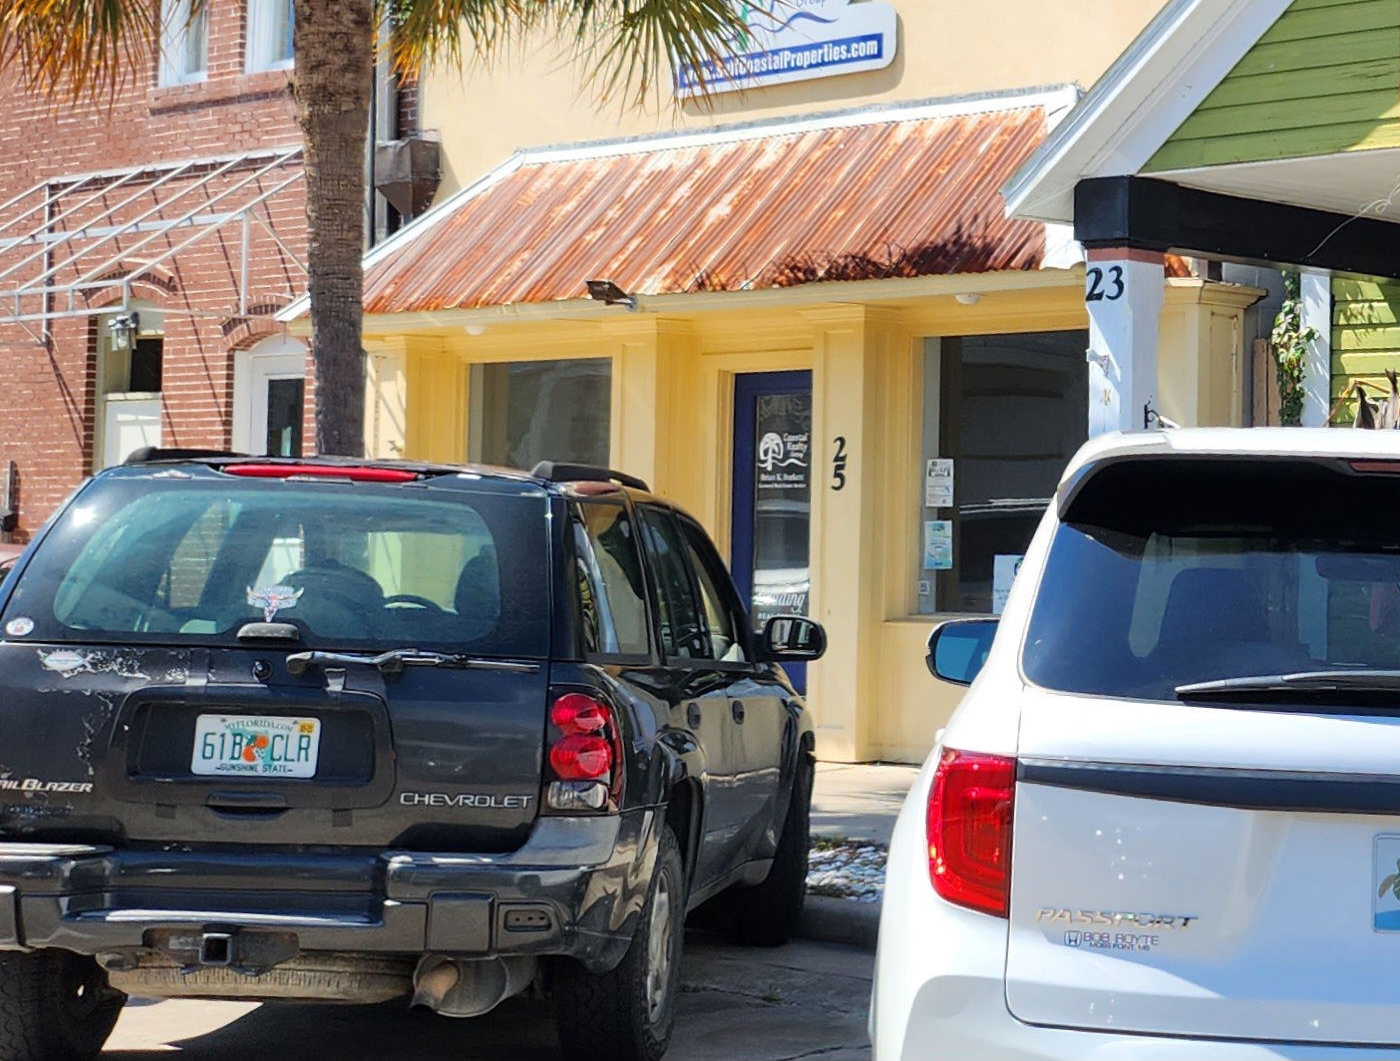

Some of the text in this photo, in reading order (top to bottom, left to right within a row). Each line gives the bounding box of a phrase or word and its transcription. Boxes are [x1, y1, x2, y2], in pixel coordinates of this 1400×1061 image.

[1086, 266, 1124, 301] 23
[202, 732, 312, 763] 61B CLR
[219, 764, 288, 774] SUNSHINE STATE
[0, 778, 94, 793] AILBLAZER
[400, 792, 534, 808] CHEVROLET
[1036, 907, 1199, 930] PASSPORT
[1084, 932, 1159, 946] BOB BOYTE
